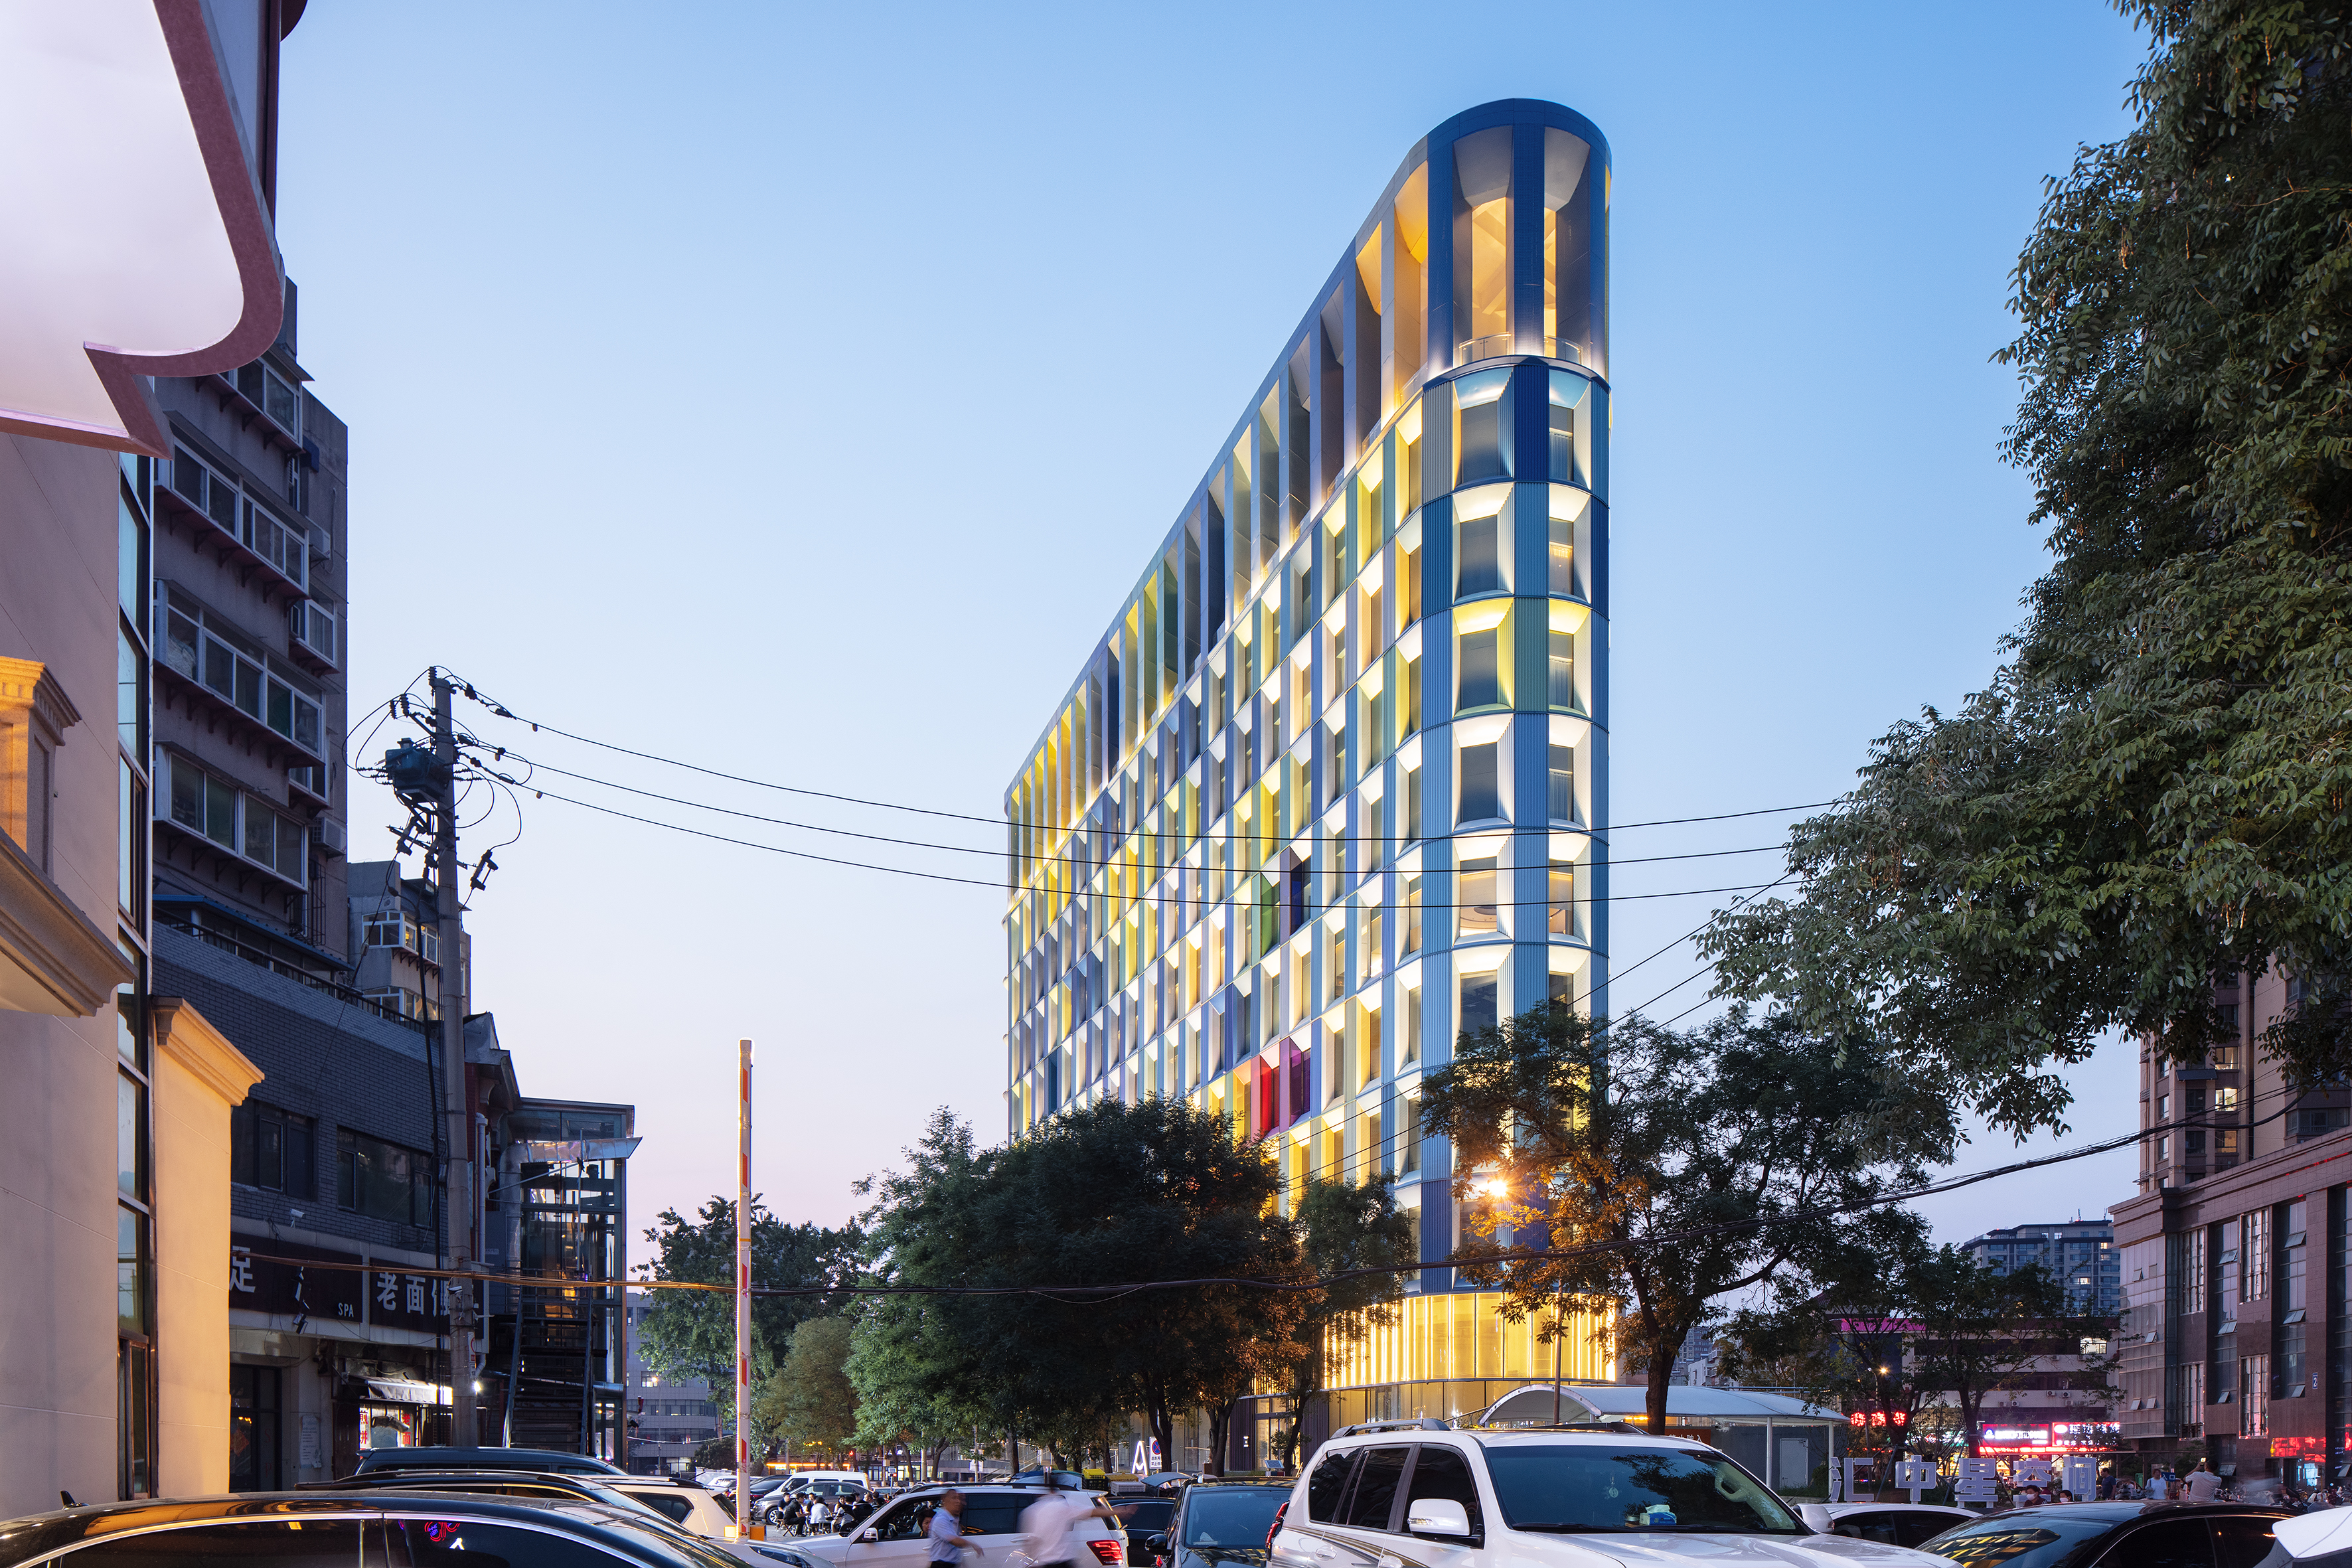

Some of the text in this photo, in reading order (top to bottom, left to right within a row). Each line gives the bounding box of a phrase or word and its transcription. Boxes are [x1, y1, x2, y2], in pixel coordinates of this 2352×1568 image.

[338, 1302, 354, 1318] SPA
[1830, 1454, 2096, 1503] 汇中星空间
